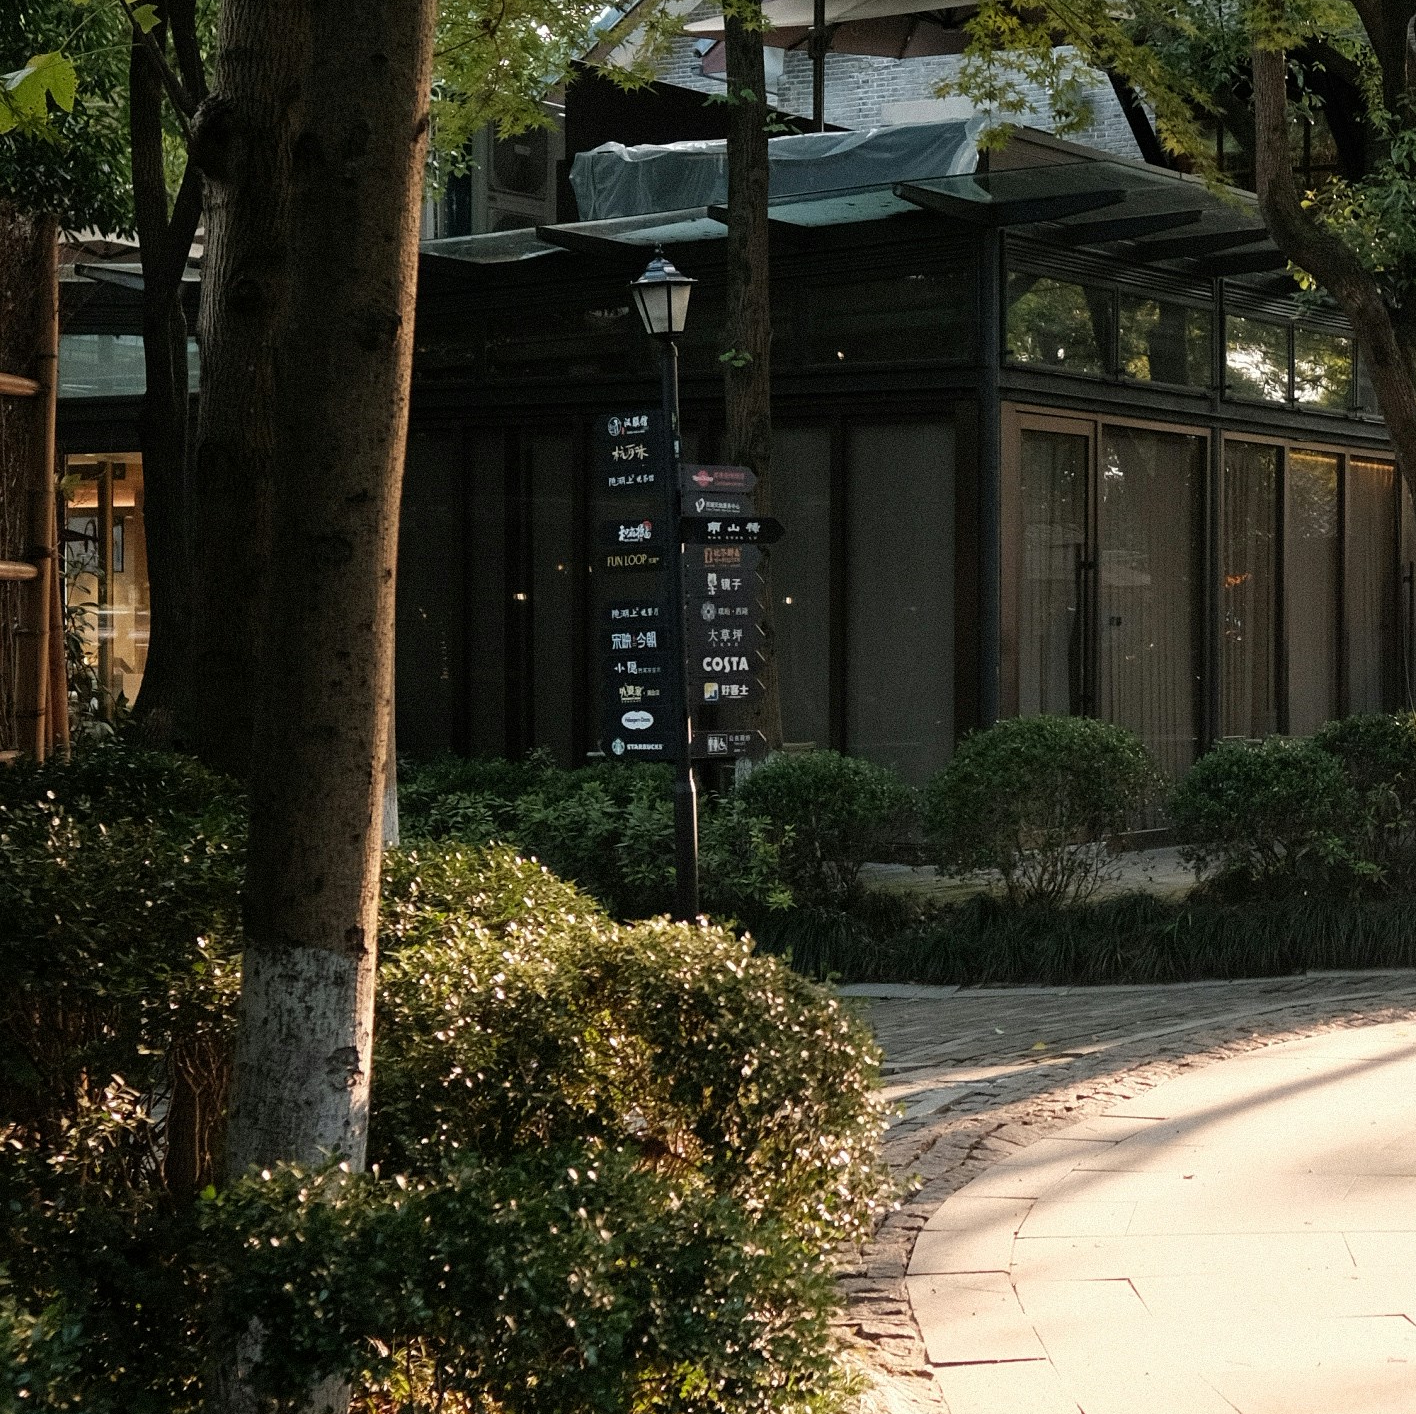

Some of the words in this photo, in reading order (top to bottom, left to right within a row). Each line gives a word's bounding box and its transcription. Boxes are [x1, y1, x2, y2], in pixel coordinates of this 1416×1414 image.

[607, 555, 623, 567] FUN
[624, 553, 648, 567] LOOP
[708, 628, 743, 643] 大草坪
[702, 656, 749, 673] COSTA
[619, 683, 645, 698] 外婆家
